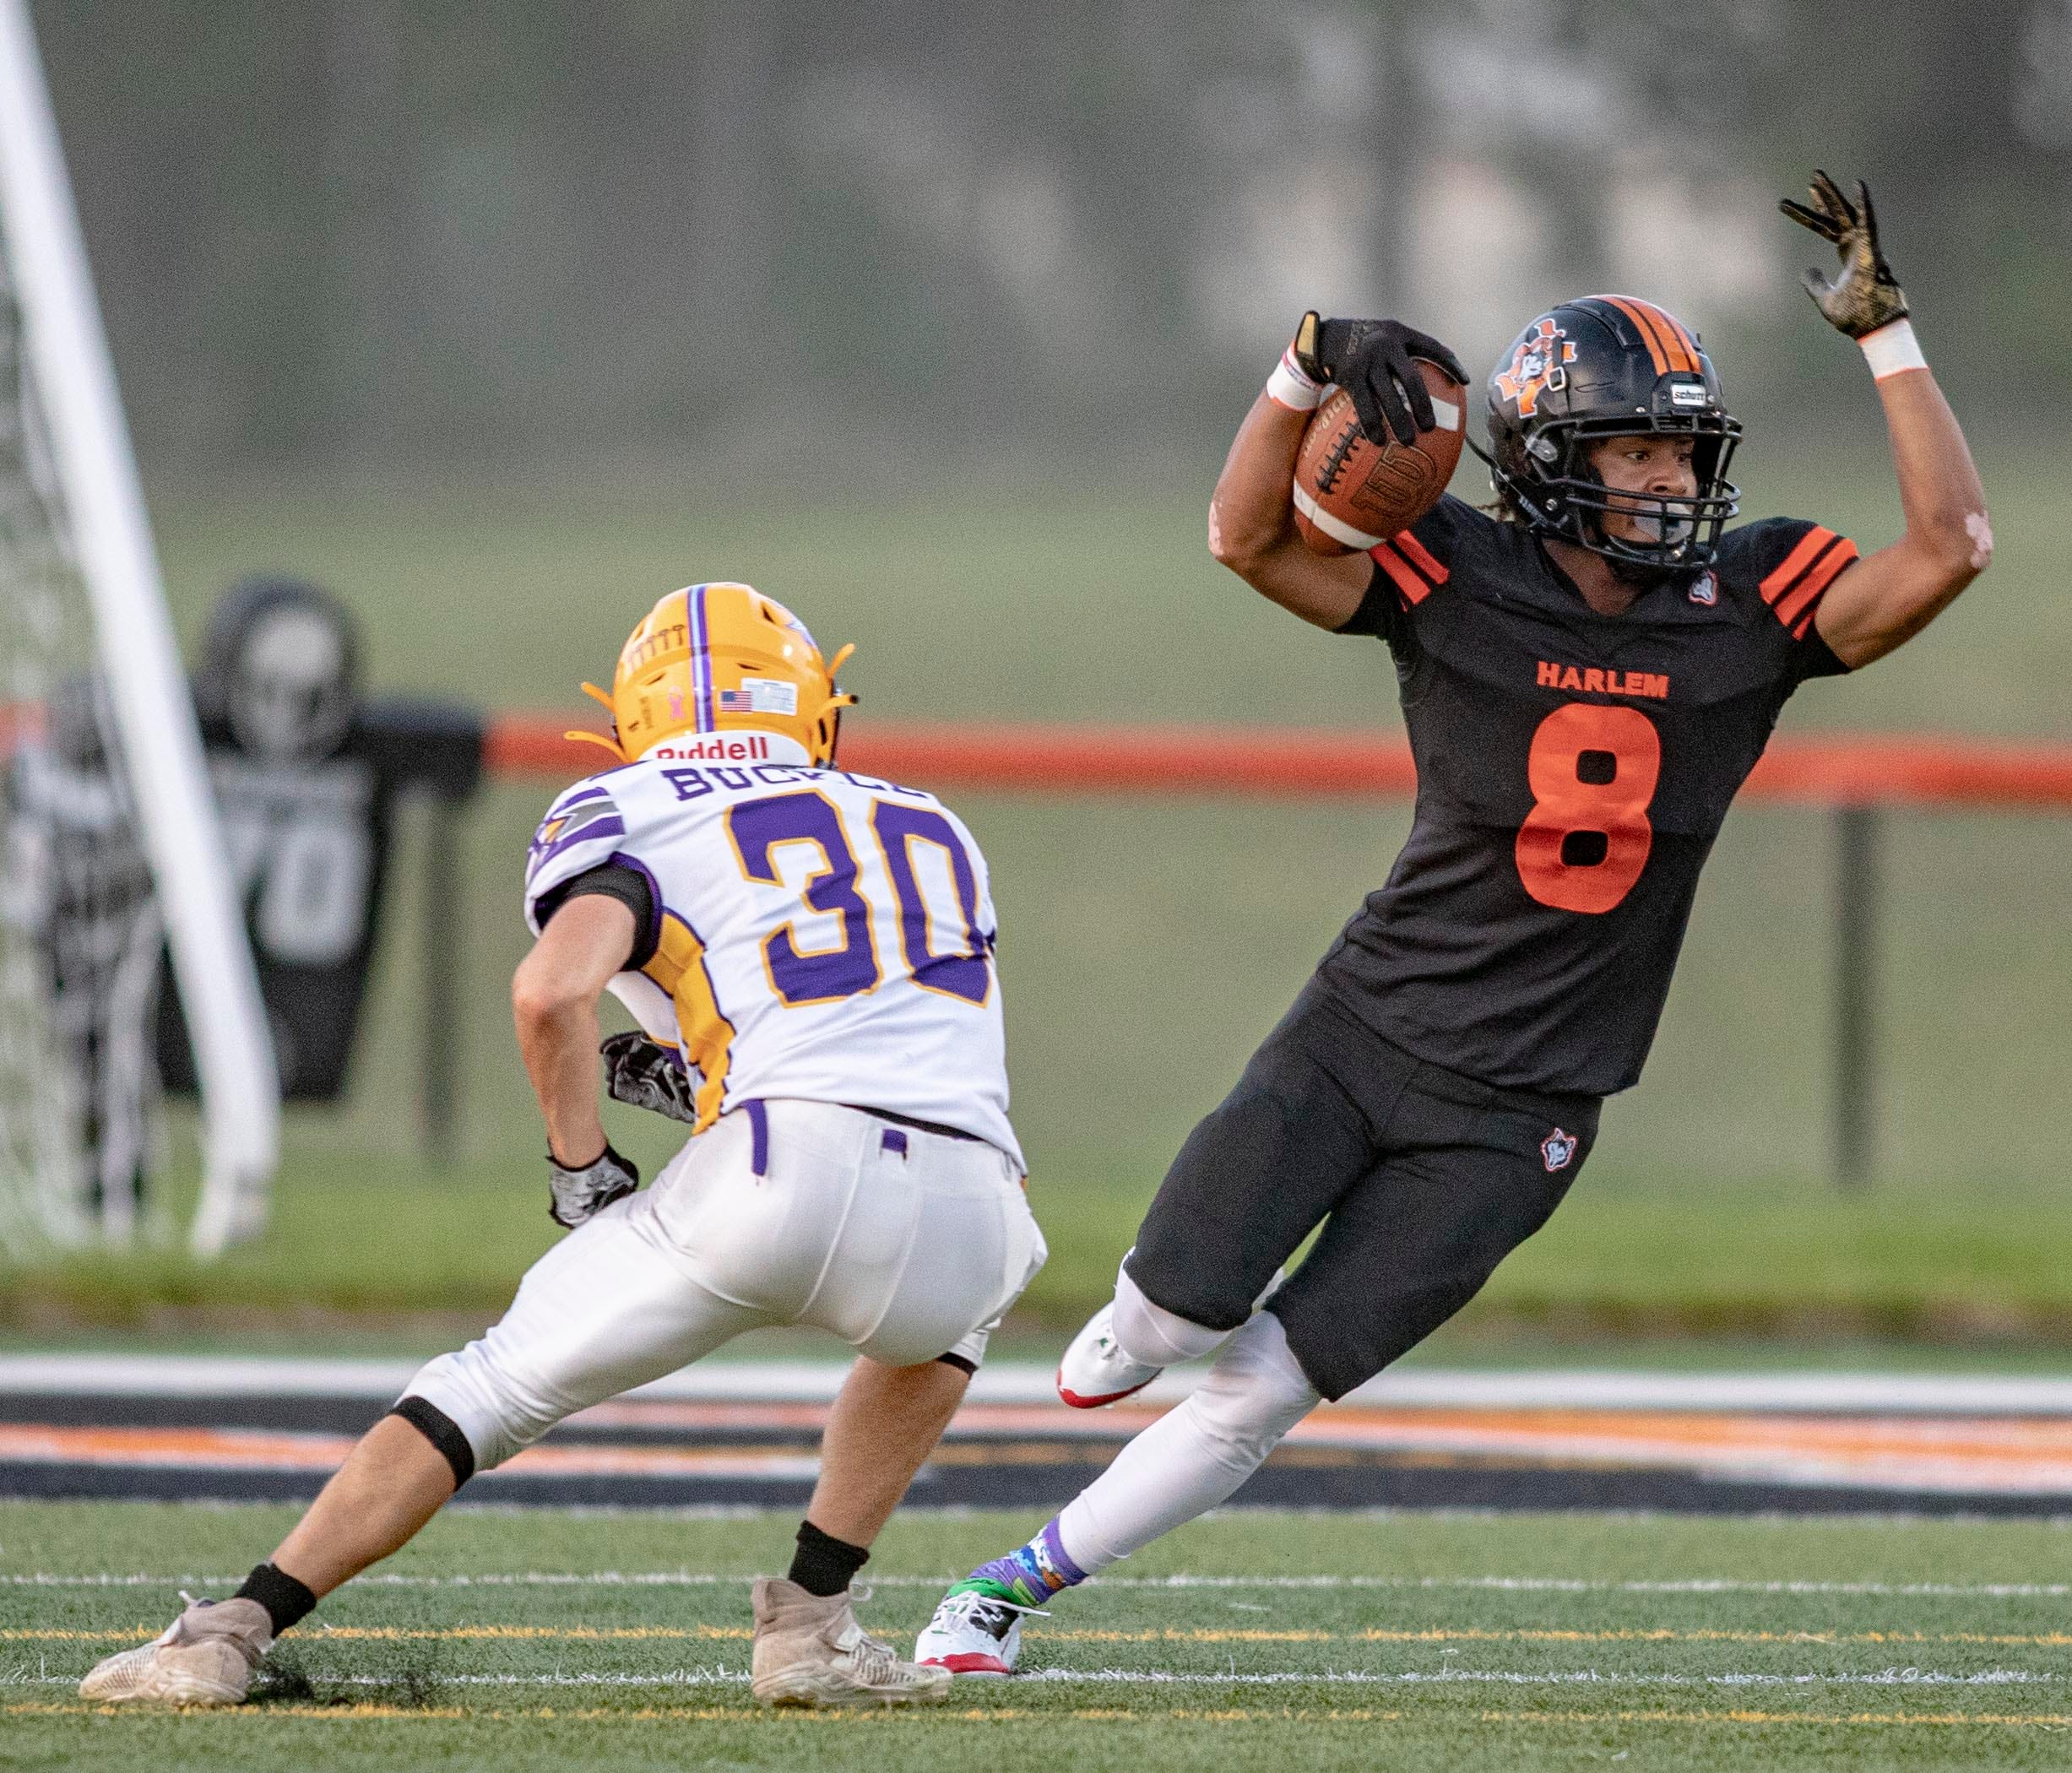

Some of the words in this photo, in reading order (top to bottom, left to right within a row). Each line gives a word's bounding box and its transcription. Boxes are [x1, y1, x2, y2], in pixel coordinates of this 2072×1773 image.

[1536, 660, 1669, 699] HARLEM
[723, 787, 995, 1010] 30
[1514, 702, 1662, 914] 8
